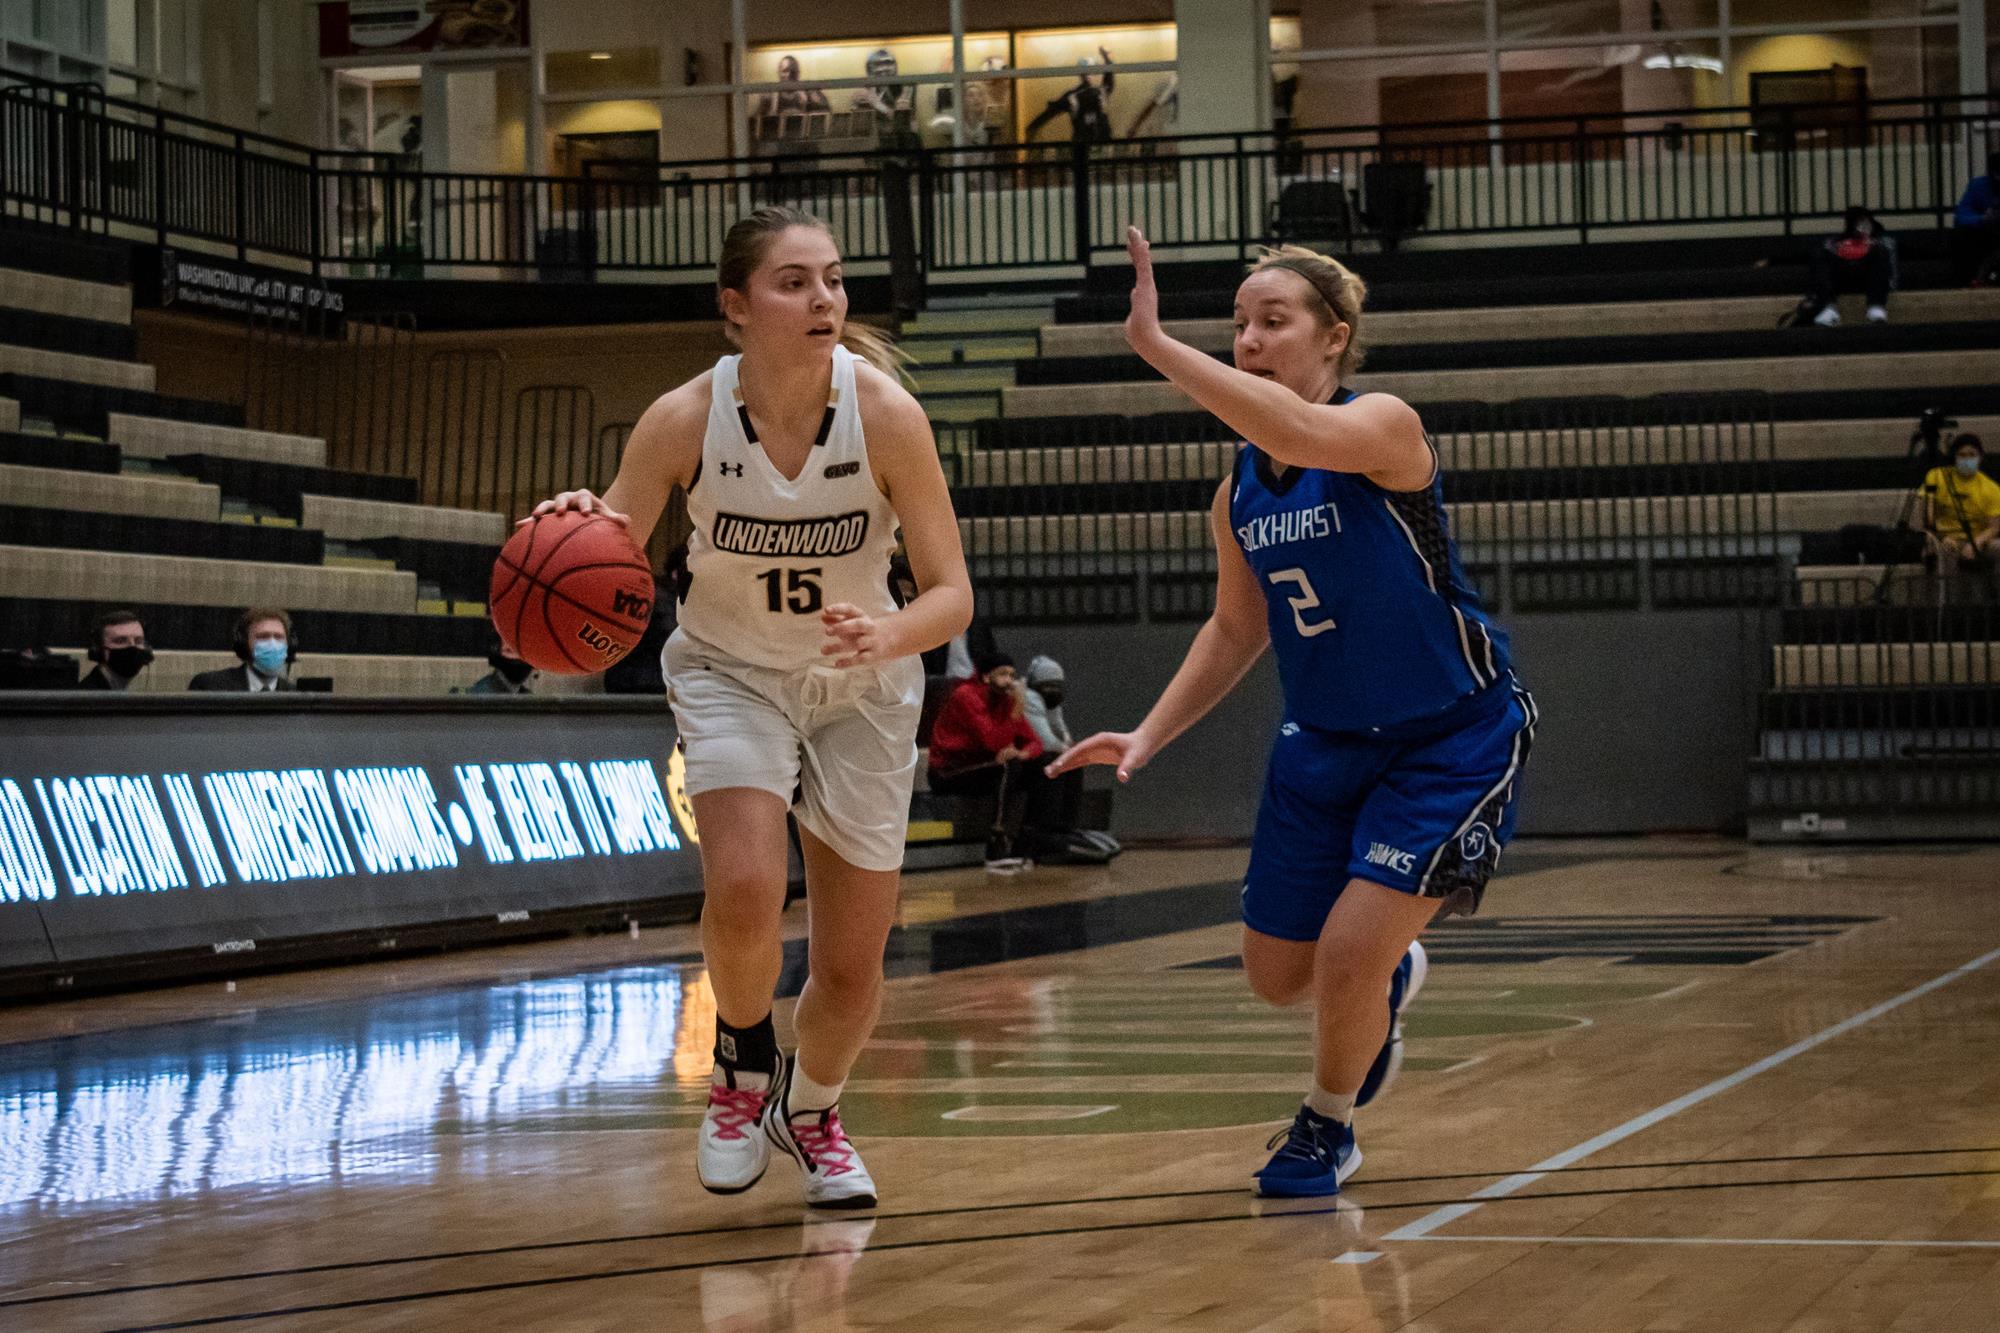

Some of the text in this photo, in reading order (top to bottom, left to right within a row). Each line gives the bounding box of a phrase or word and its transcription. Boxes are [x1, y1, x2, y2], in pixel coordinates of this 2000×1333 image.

[178, 263, 238, 291] WASHINGTON
[239, 277, 286, 299] UNIERITY
[289, 286, 343, 312] ORTOPDICS
[715, 515, 865, 555] LINDENWOOD
[614, 589, 652, 620] CAA
[756, 568, 822, 614] 15
[1268, 567, 1336, 637] 2
[33, 775, 188, 896] LOCATION
[162, 773, 227, 887] IN
[203, 769, 356, 882] UNIVERSITY
[333, 767, 458, 875] COMMONS
[453, 764, 514, 864] WE
[488, 763, 585, 862] DELIVER
[559, 762, 611, 856] TO
